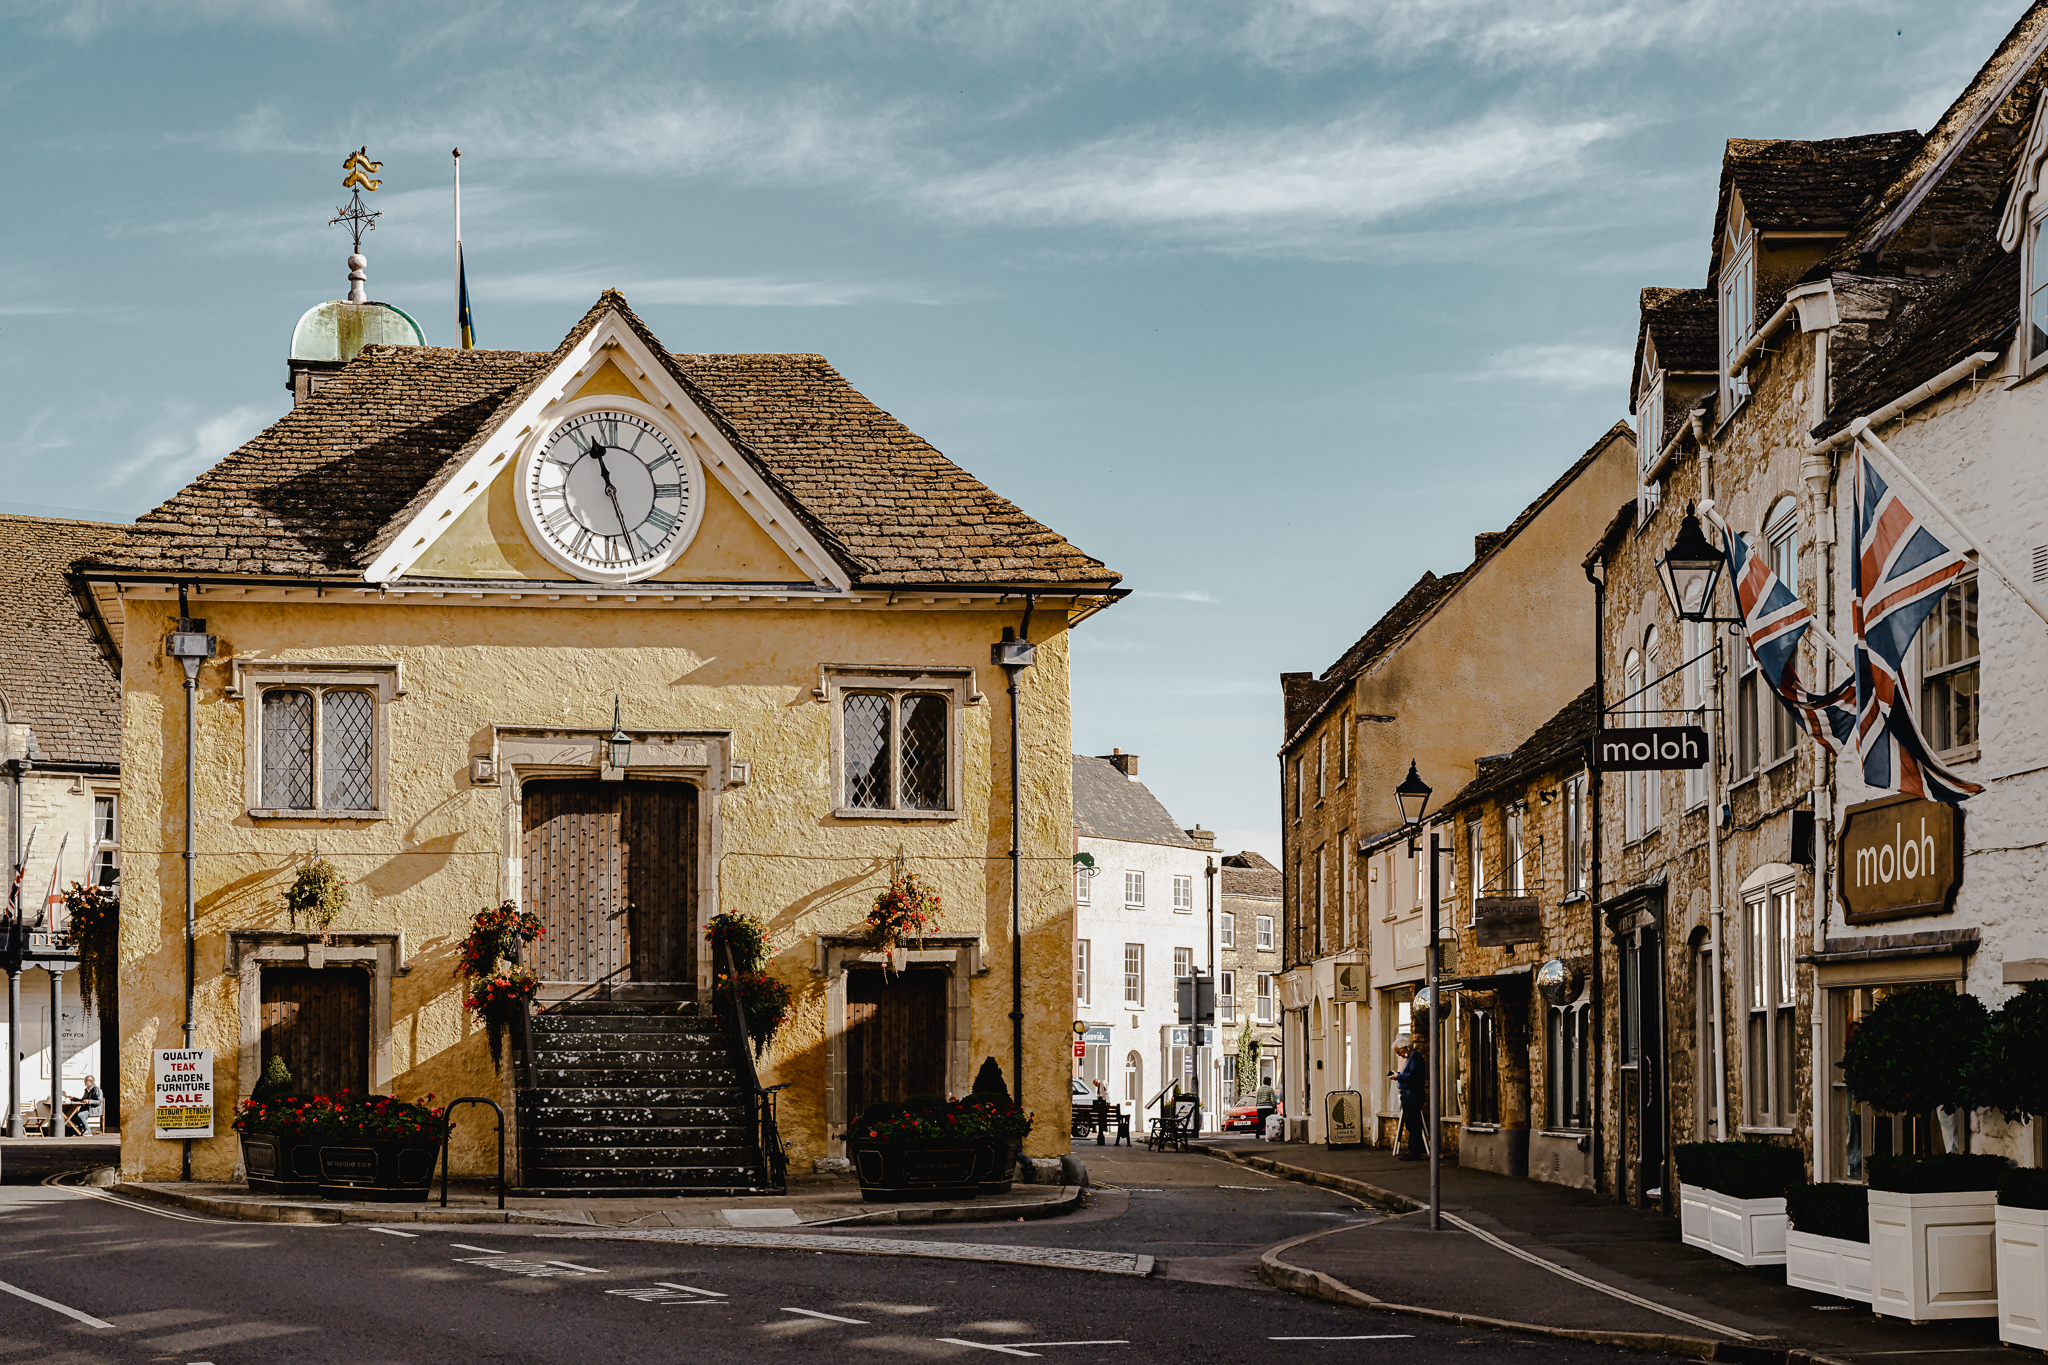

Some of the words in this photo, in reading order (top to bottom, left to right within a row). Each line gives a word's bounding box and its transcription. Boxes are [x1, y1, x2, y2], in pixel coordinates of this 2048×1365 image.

[655, 483, 681, 498] III
[1603, 732, 1698, 761] moloh
[1857, 817, 1935, 888] moloh
[163, 1052, 203, 1060] QUALITY
[171, 1063, 195, 1071] TEAK
[164, 1074, 203, 1082] GARDEN
[157, 1083, 210, 1092] FURNITURE
[165, 1094, 203, 1103] SALE
[185, 1107, 211, 1115] TETBURY
